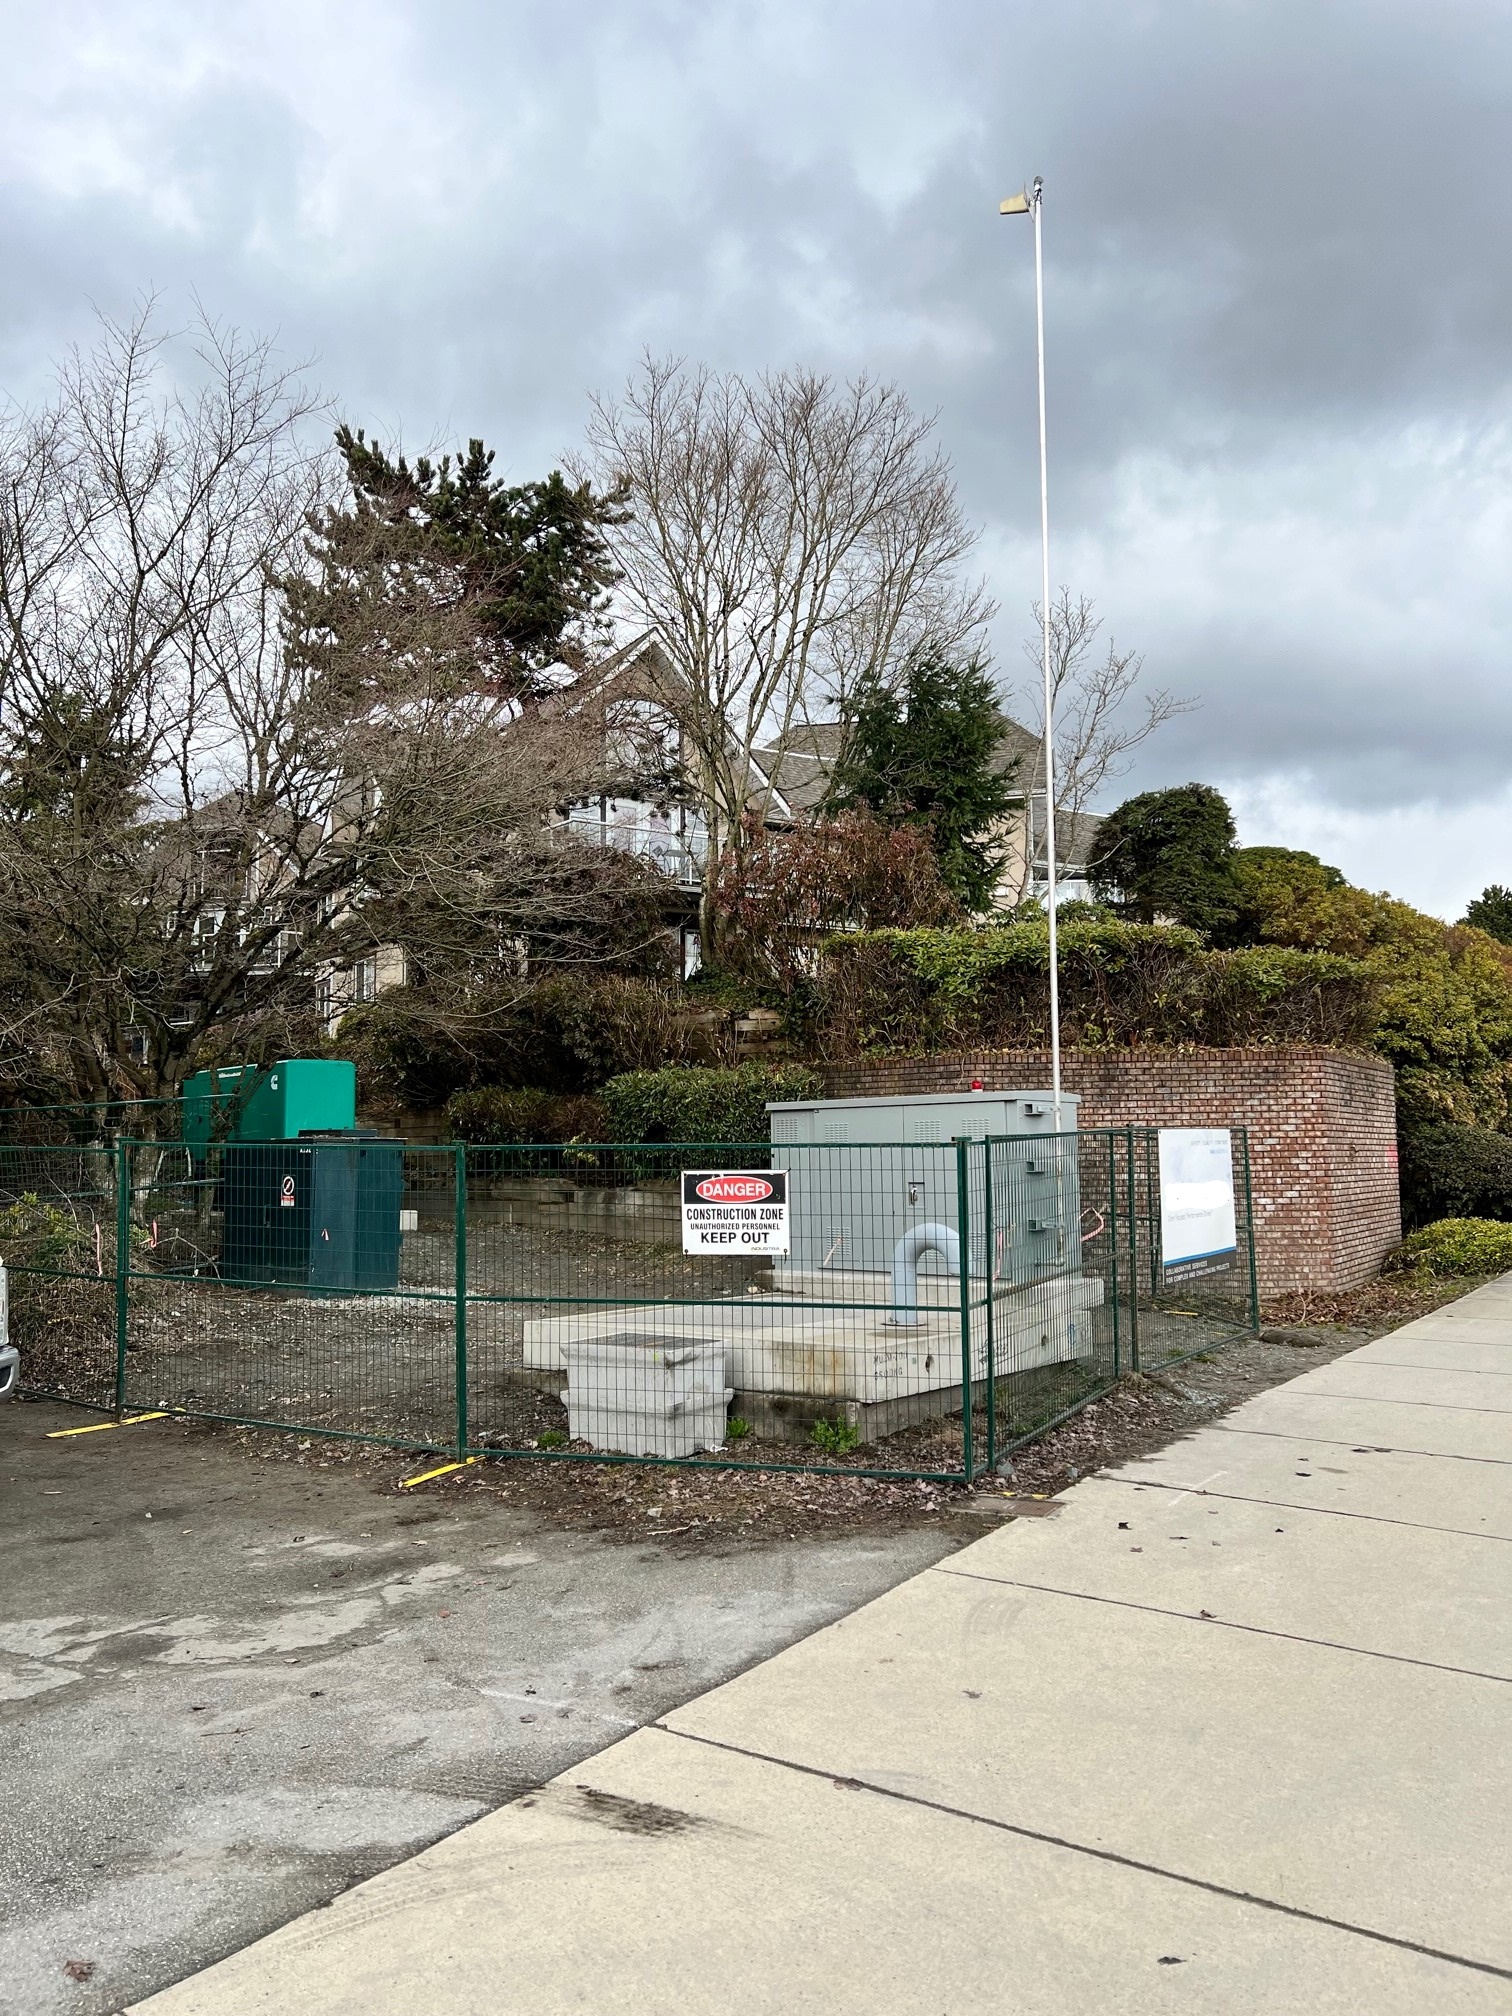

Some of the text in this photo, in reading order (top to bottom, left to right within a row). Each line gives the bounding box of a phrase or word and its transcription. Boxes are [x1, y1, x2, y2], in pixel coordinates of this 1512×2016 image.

[703, 1183, 766, 1196] DANGER
[686, 1208, 784, 1220] CONSTRUCTION ZONE
[701, 1232, 770, 1243] KEEP OUT
[1192, 1260, 1207, 1269] SERVICES
